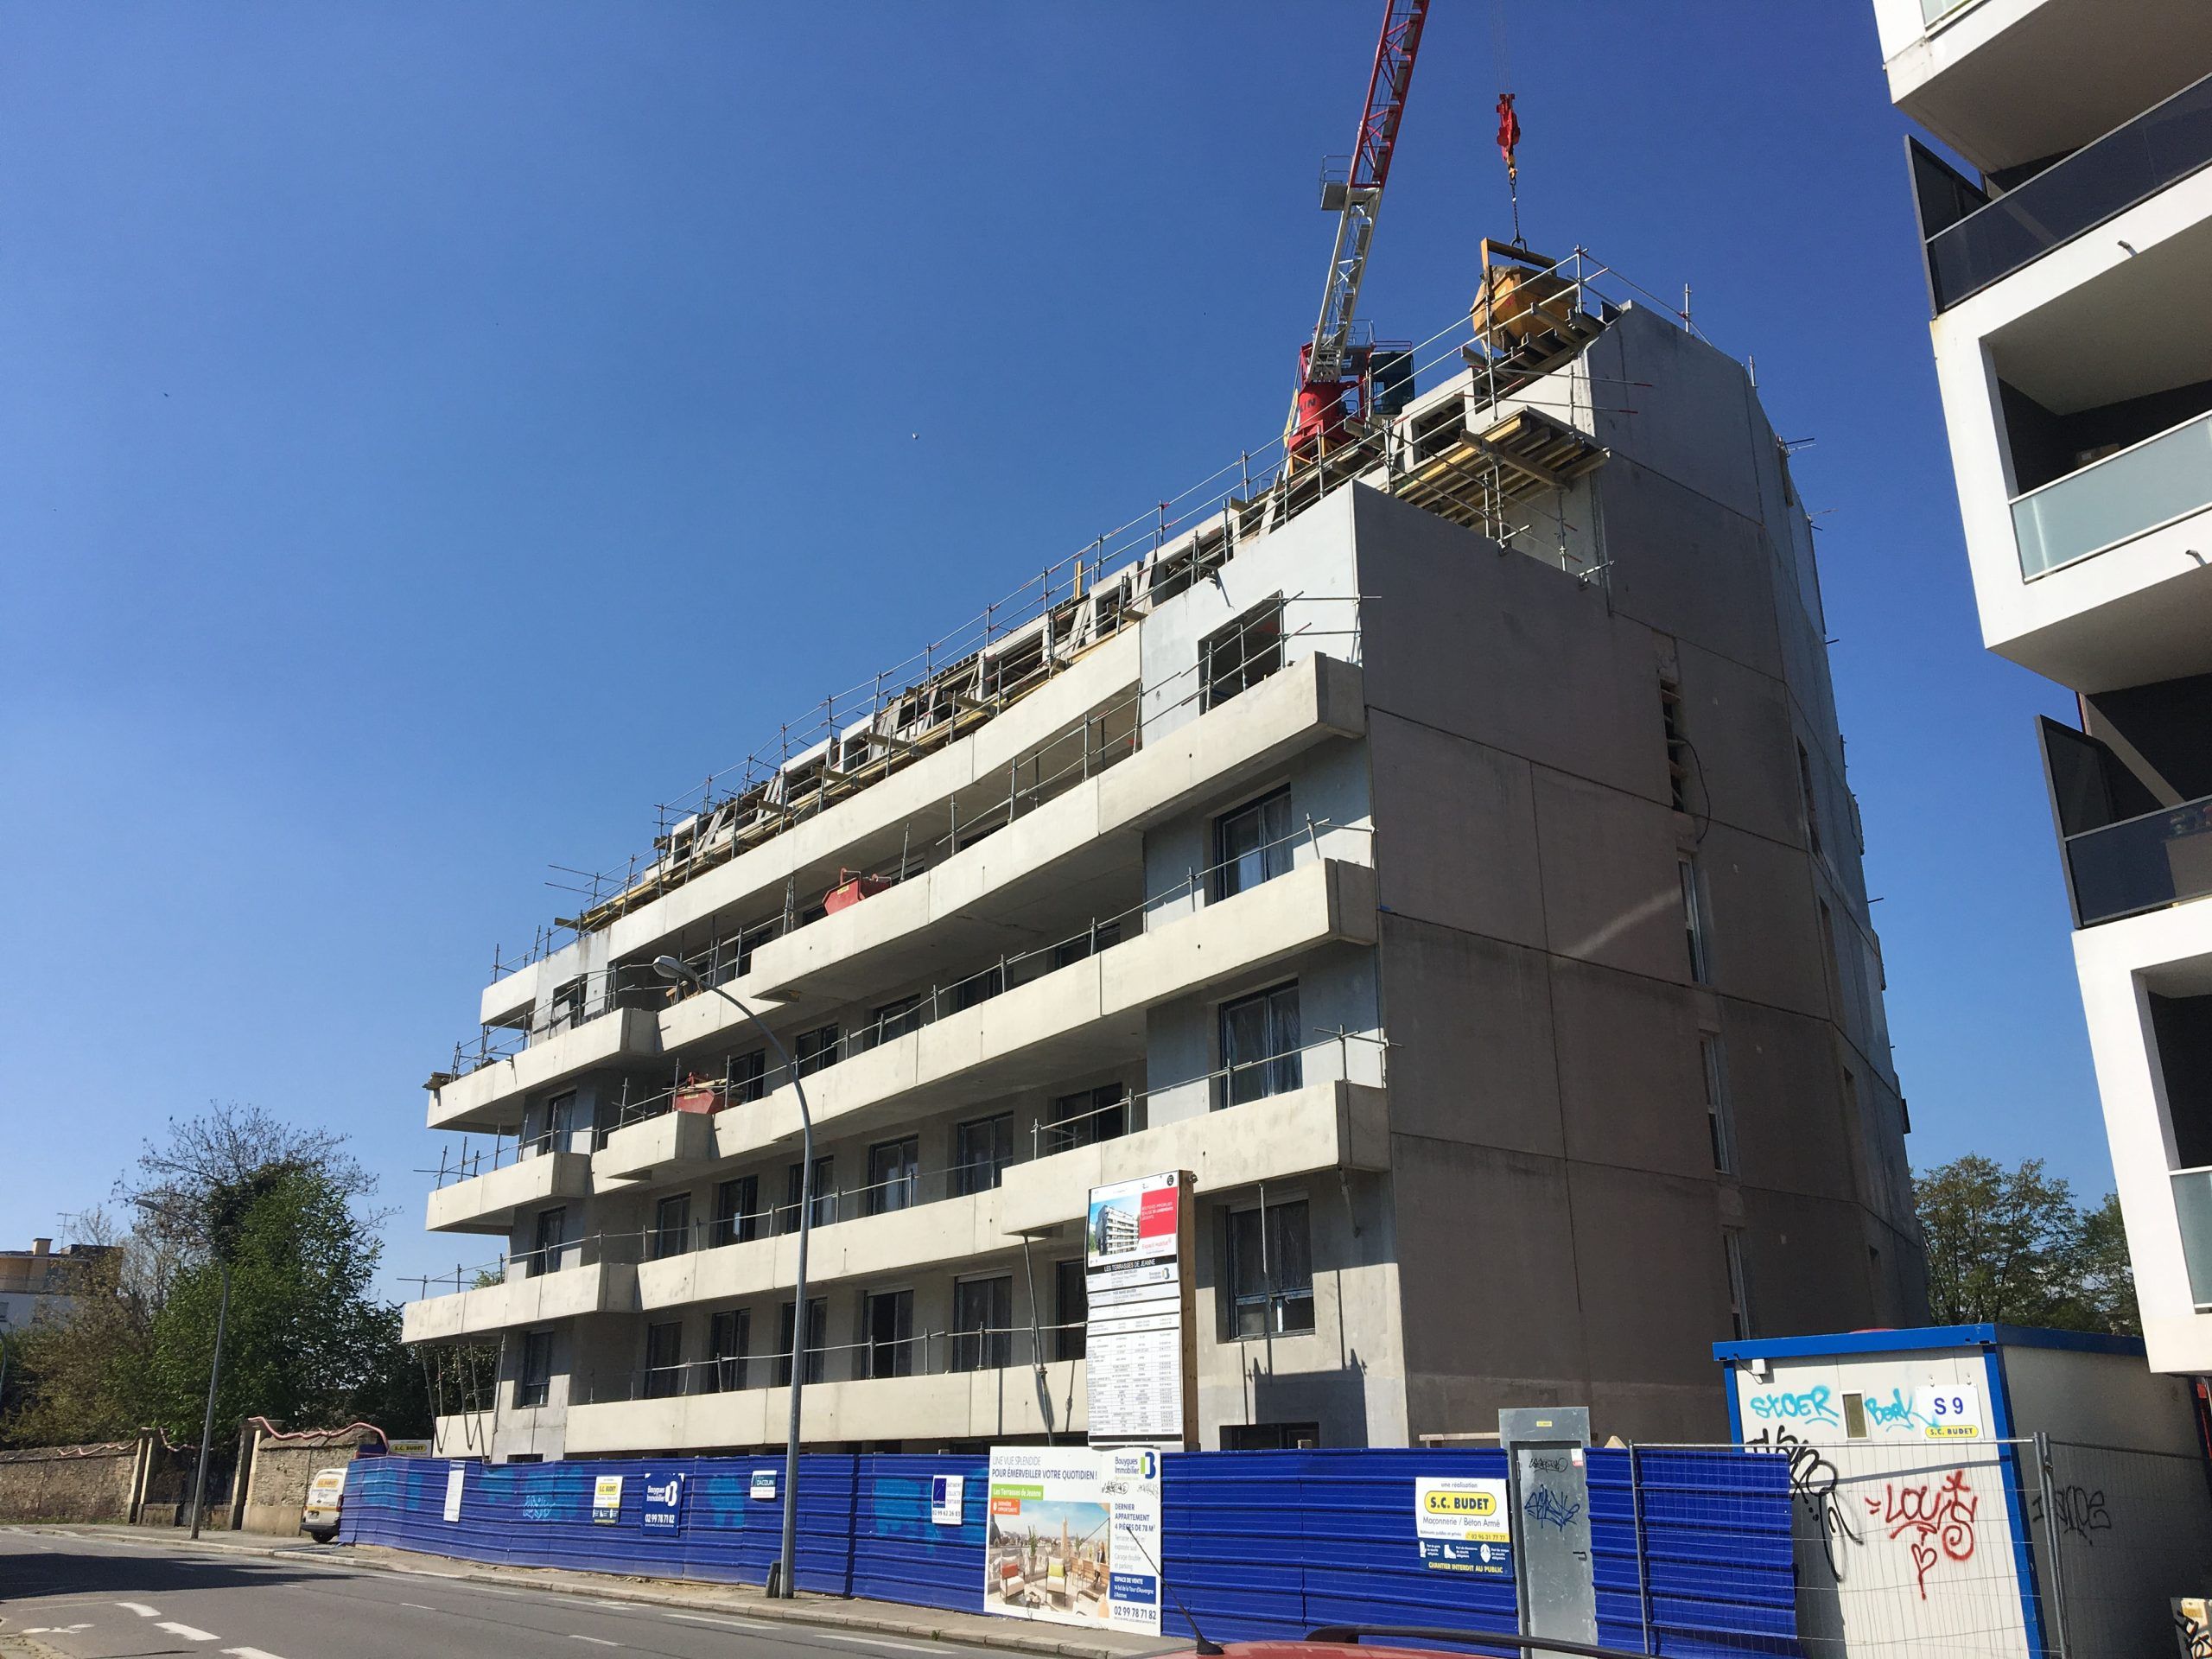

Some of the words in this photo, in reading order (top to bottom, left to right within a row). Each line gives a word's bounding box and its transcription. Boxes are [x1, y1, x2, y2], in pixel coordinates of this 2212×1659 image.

[1112, 1262, 1134, 1271] TERRASSES
[1934, 1397, 1947, 1415] S
[1953, 1397, 1963, 1414] 9
[993, 1456, 1003, 1465] UNE
[1003, 1456, 1014, 1465] VUE
[1015, 1456, 1041, 1465] SPLENDIDE
[1116, 1457, 1138, 1468] Bouygues
[993, 1469, 1006, 1478] POUR
[1007, 1467, 1041, 1478] ÉMERVEILLER
[1043, 1470, 1060, 1479] VOTRE
[1063, 1471, 1094, 1481] QUOTIDIEN
[647, 1485, 665, 1497] Bouygues
[1001, 1488, 1020, 1497] Terrasses
[1021, 1488, 1027, 1497] de
[1027, 1489, 1041, 1497] Jeanne
[1431, 1497, 1450, 1509] S.C.
[1454, 1497, 1489, 1510] BUDET
[645, 1514, 651, 1522] 02
[652, 1514, 657, 1523] 99
[658, 1514, 663, 1523] 78
[664, 1515, 669, 1523] 71
[669, 1515, 675, 1523] 82
[1423, 1516, 1457, 1526] Maçonnerie
[1464, 1517, 1482, 1527] Béton
[1484, 1519, 1500, 1528] Armé
[1115, 1606, 1122, 1616] 02
[1123, 1606, 1130, 1617] 99
[1132, 1608, 1139, 1618] 78
[1141, 1609, 1147, 1618] 71
[1149, 1610, 1156, 1619] 82
